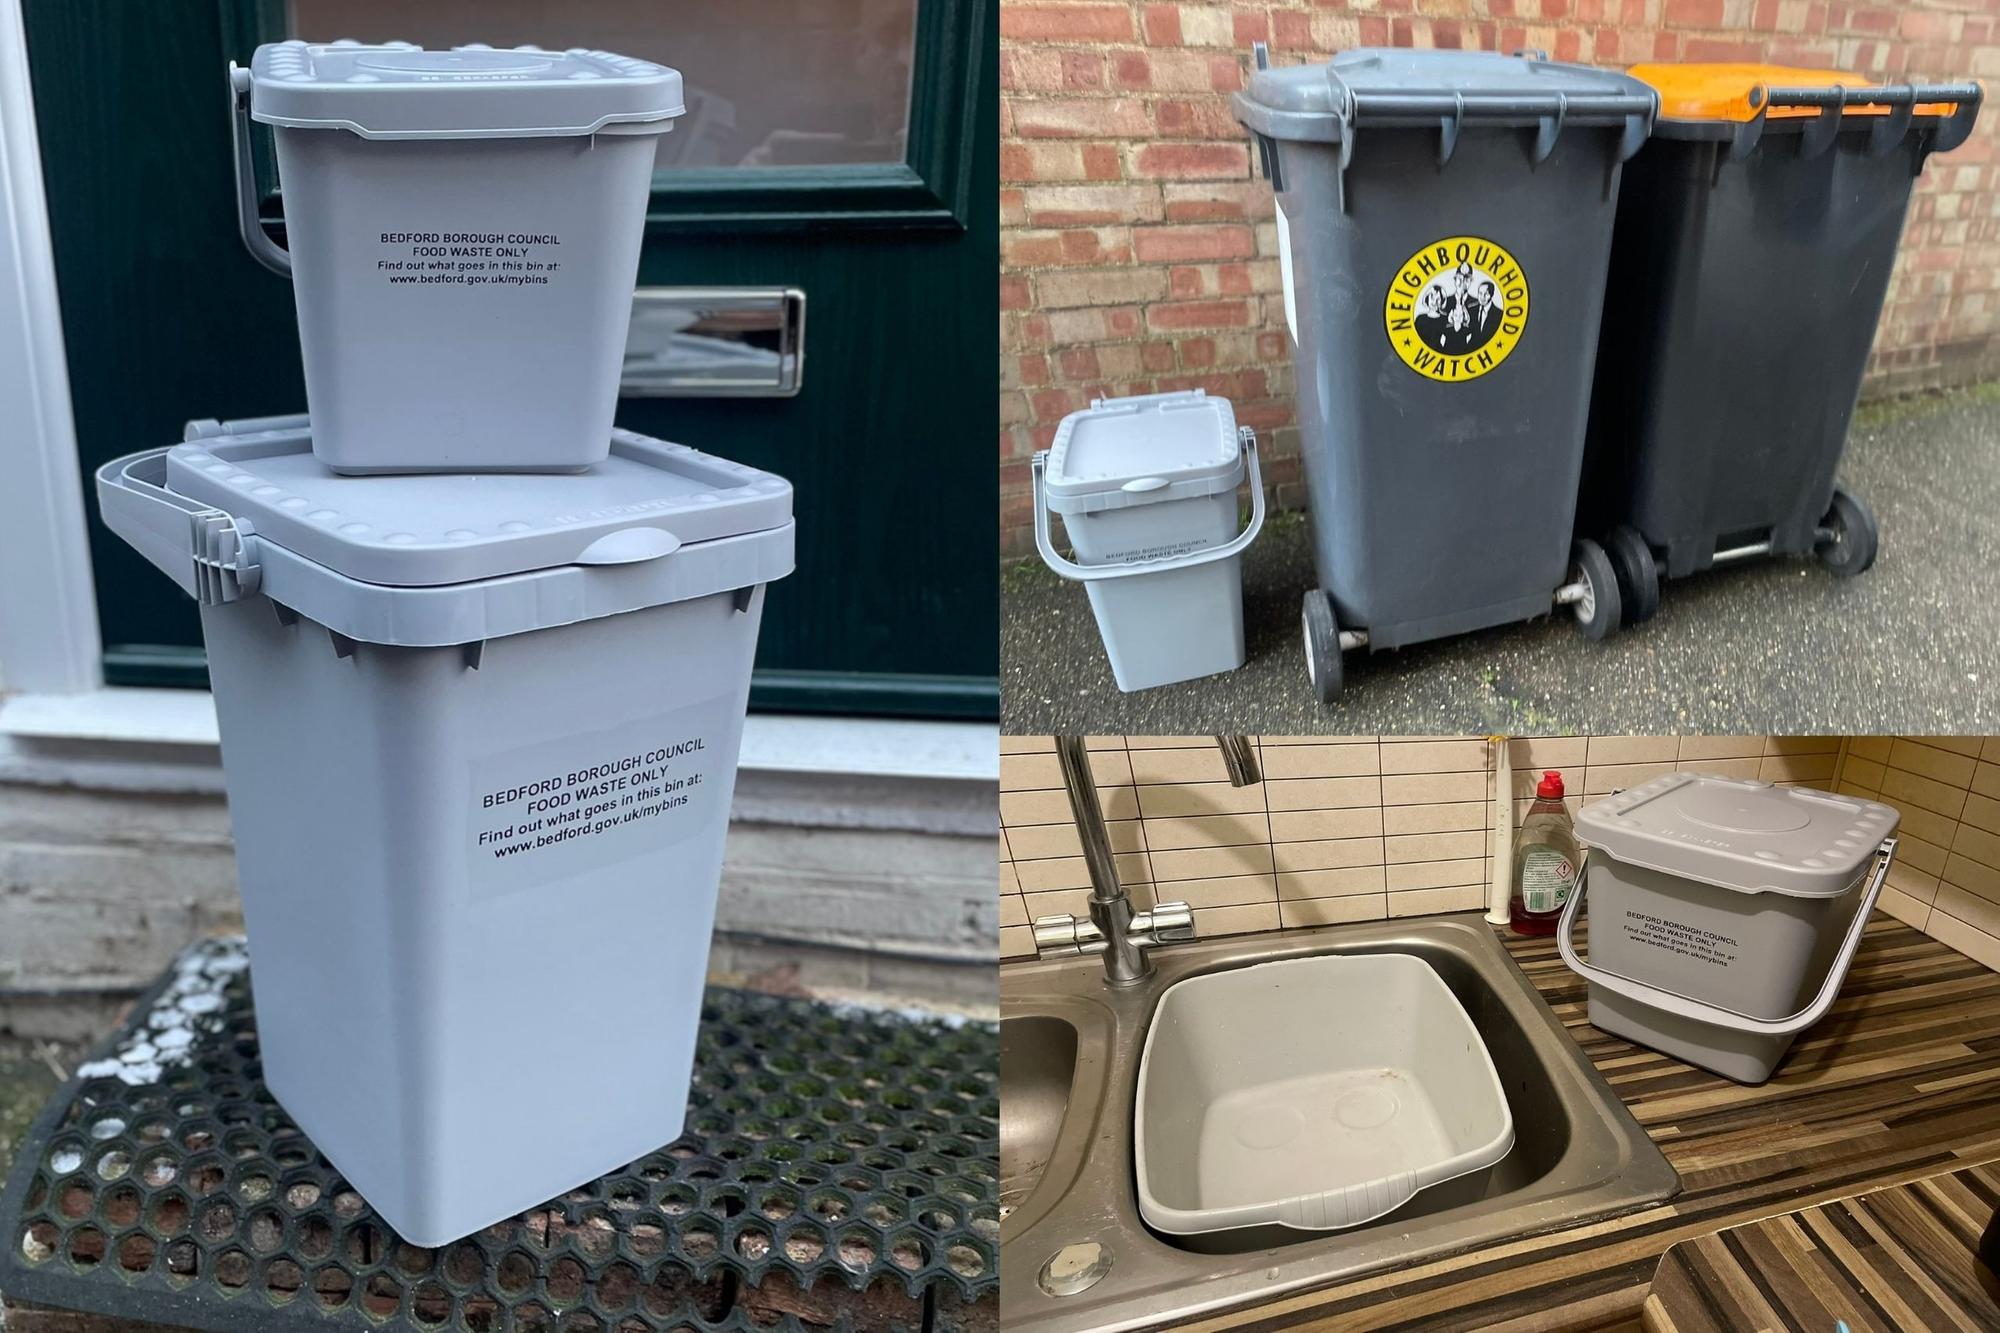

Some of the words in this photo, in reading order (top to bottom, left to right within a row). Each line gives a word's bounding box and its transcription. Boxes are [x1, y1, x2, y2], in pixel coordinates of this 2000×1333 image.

[381, 233, 439, 243] BEDFORD
[443, 233, 504, 244] BOROUGH
[507, 234, 560, 245] COUNCIL
[412, 247, 447, 256] FOOD
[450, 247, 492, 257] WASTE
[496, 248, 529, 257] ONLY
[378, 261, 403, 270] Find
[406, 262, 424, 270] out
[428, 261, 455, 270] what
[458, 263, 485, 272] goes
[488, 261, 499, 270] in
[502, 261, 523, 271] this
[526, 261, 543, 271] bin
[390, 274, 548, 286] www.bedford.gov.uk/mybins
[1391, 242, 1524, 335] NEIGHBOURHOOD
[1413, 348, 1493, 377] WATCH
[483, 777, 562, 808] BEDFORD
[567, 756, 642, 786] BOROUGH
[645, 738, 705, 764] COUNCIL
[527, 793, 571, 815] FOOD
[575, 777, 626, 801] WASTE
[631, 765, 669, 785] ONLY
[479, 826, 513, 845] Find
[518, 820, 542, 835] out
[547, 809, 581, 828] what
[584, 801, 617, 820] goes
[621, 794, 633, 807] in
[637, 786, 661, 801] this
[665, 780, 684, 793] bin
[687, 773, 703, 786] at:
[494, 794, 688, 858] www.bedford.gov.uk/mybins
[1623, 925, 1639, 934] Find
[1653, 933, 1670, 941] what
[1671, 939, 1688, 947] goes
[1699, 945, 1712, 954] this
[1626, 910, 1662, 925] BEDFORD
[1663, 920, 1702, 936] BOROUGH
[1703, 931, 1738, 947] COUNCIL
[1644, 923, 1665, 933] FOOD
[1667, 928, 1693, 941] WASTE
[1696, 936, 1717, 947] ONLY
[1630, 935, 1728, 967] www.bedford.gov.uk/mybins
